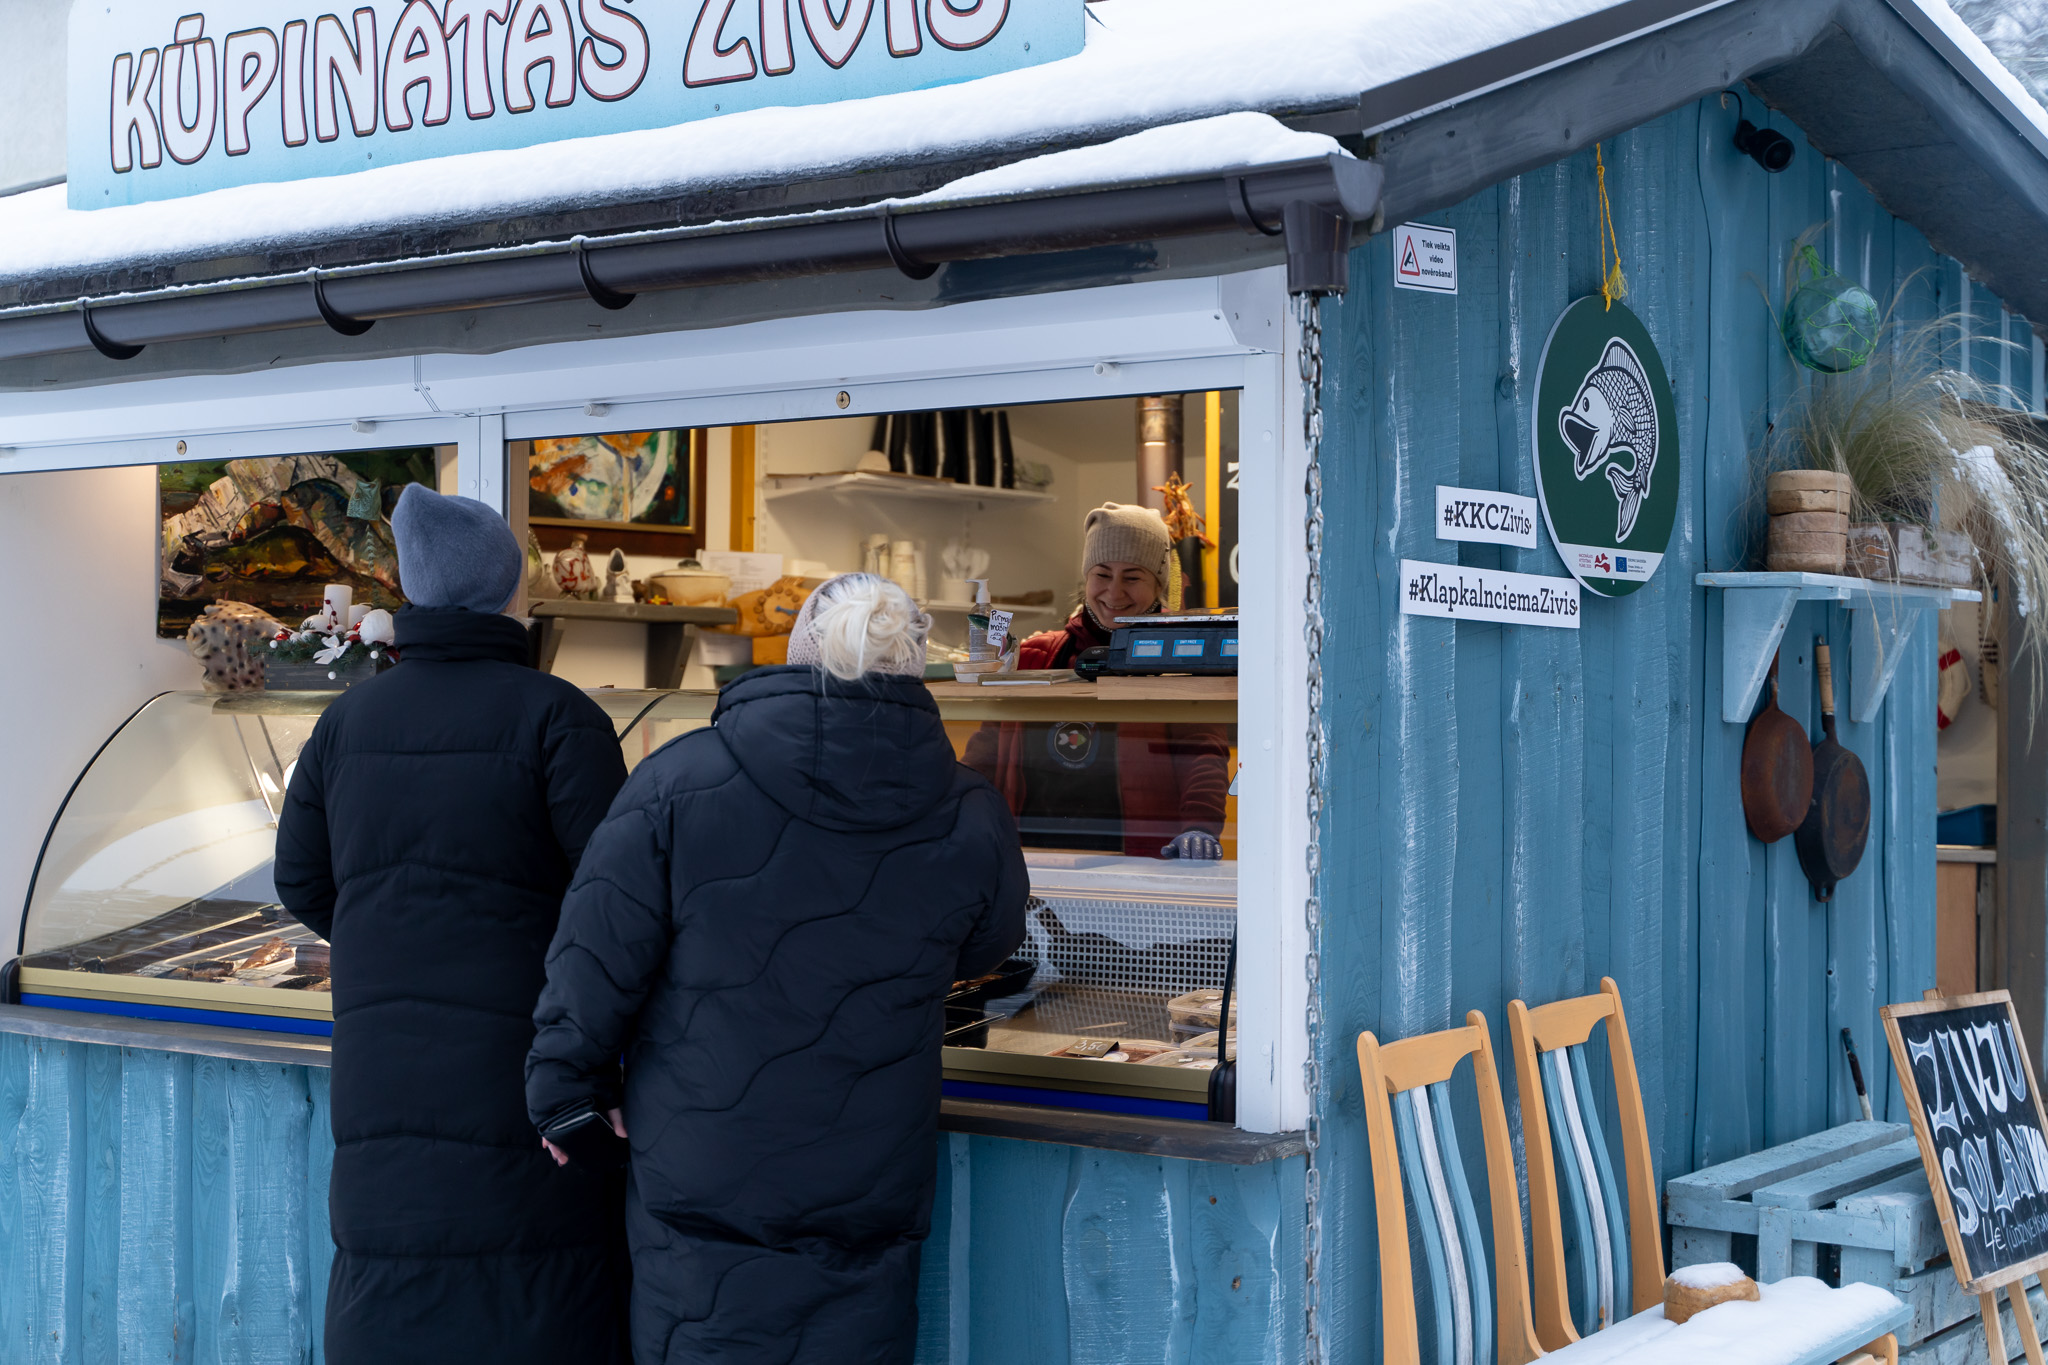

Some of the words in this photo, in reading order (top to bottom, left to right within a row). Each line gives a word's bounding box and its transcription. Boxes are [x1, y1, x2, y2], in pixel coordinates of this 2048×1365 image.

[1422, 239, 1433, 249] Tiek
[1434, 242, 1450, 251] veikta
[1429, 254, 1443, 263] video
[1422, 268, 1452, 278] novērošana!
[1443, 500, 1531, 536] #KKCZivis
[1408, 573, 1577, 616] #KlapkalnciemaZivis
[1075, 1039, 1108, 1051] 3,50
[1907, 1018, 2027, 1141] ZIVJU
